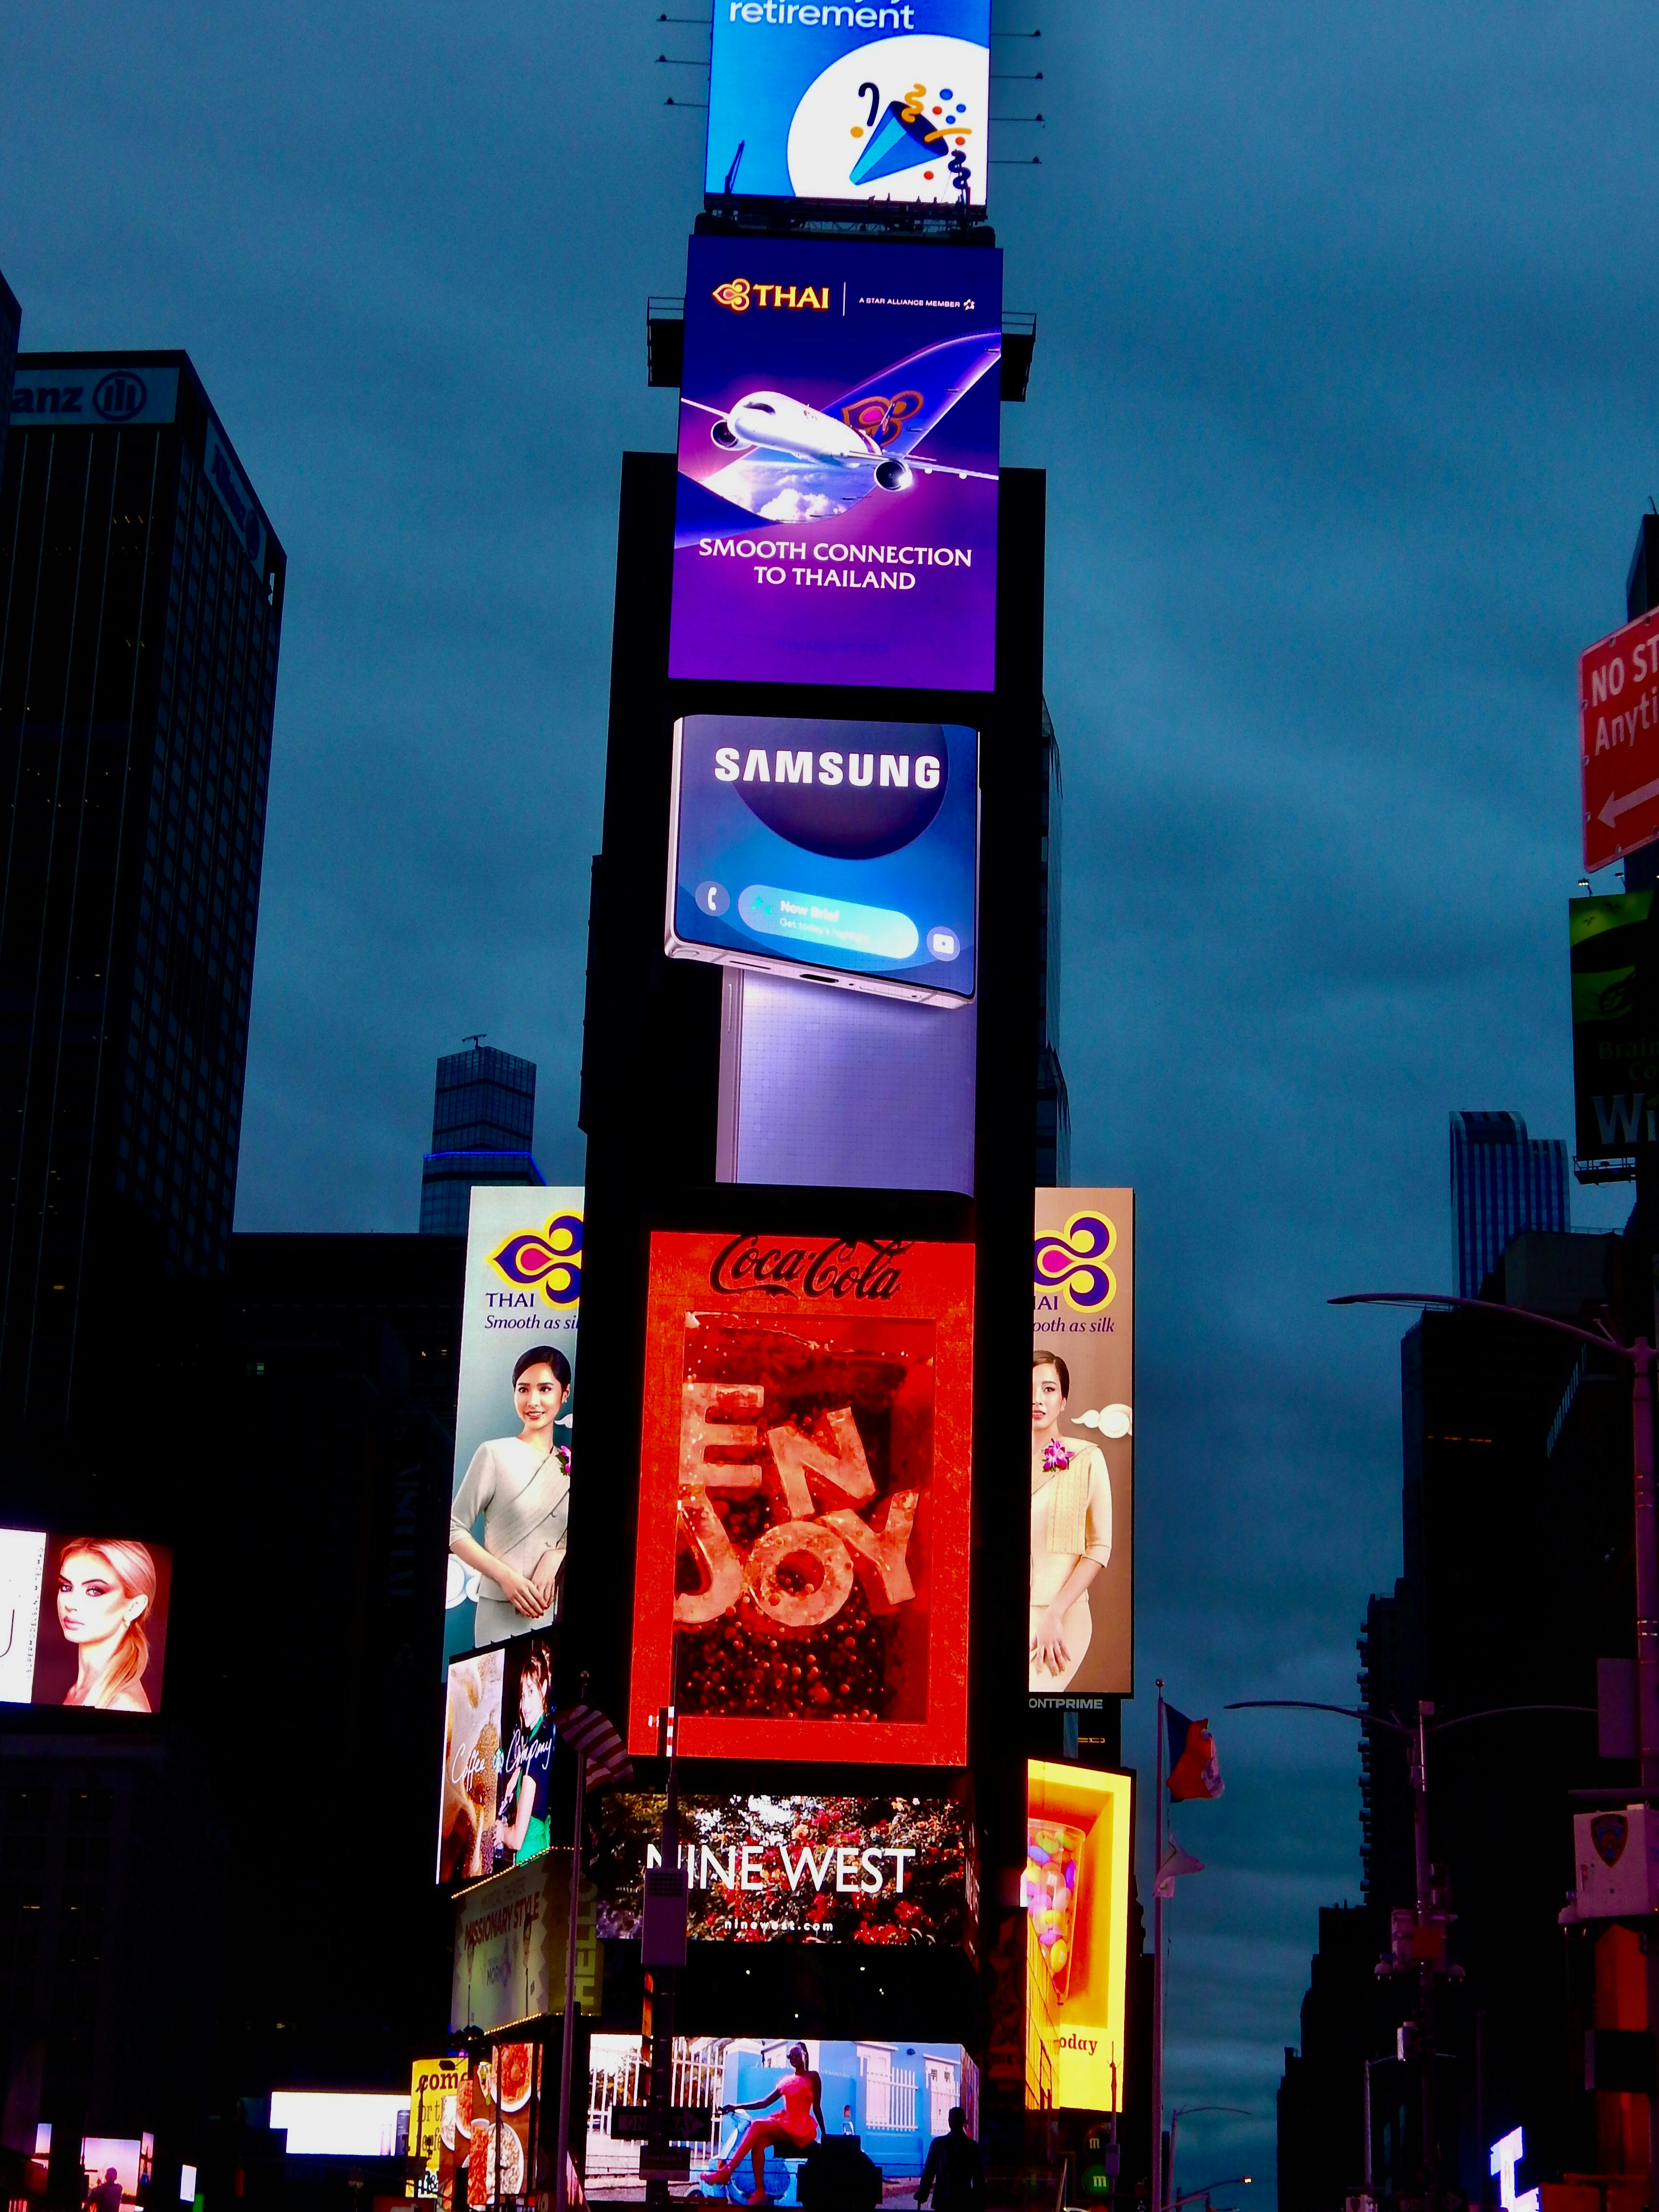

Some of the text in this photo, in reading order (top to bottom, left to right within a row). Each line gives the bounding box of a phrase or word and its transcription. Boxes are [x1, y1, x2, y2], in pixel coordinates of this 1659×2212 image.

[730, 0, 914, 29] retirement
[753, 283, 830, 309] THAI
[887, 299, 924, 307] ALLIANCE
[699, 538, 972, 567] SMOOTH CONNECTION
[754, 566, 916, 589] TO THAILAND
[1591, 656, 1625, 708] NO
[1594, 685, 1659, 756] Anyti
[714, 747, 940, 790] SAMSUNG
[1590, 1092, 1658, 1145] Wi
[485, 1292, 535, 1308] THAI
[1033, 1295, 1058, 1310] AI
[484, 1314, 540, 1329] Smooth
[543, 1318, 560, 1329] as
[1069, 1322, 1086, 1332] as
[1089, 1317, 1115, 1332] silk
[678, 1382, 876, 1519] EN
[673, 1487, 919, 1627] JOY
[451, 1743, 486, 1792] Coffee
[781, 1845, 916, 1893] WEST
[464, 1903, 514, 1951] MISSIONARY
[514, 1891, 540, 1929] STYLE
[724, 1918, 834, 1932] ninewest.com
[1093, 2175, 1107, 2188] m
